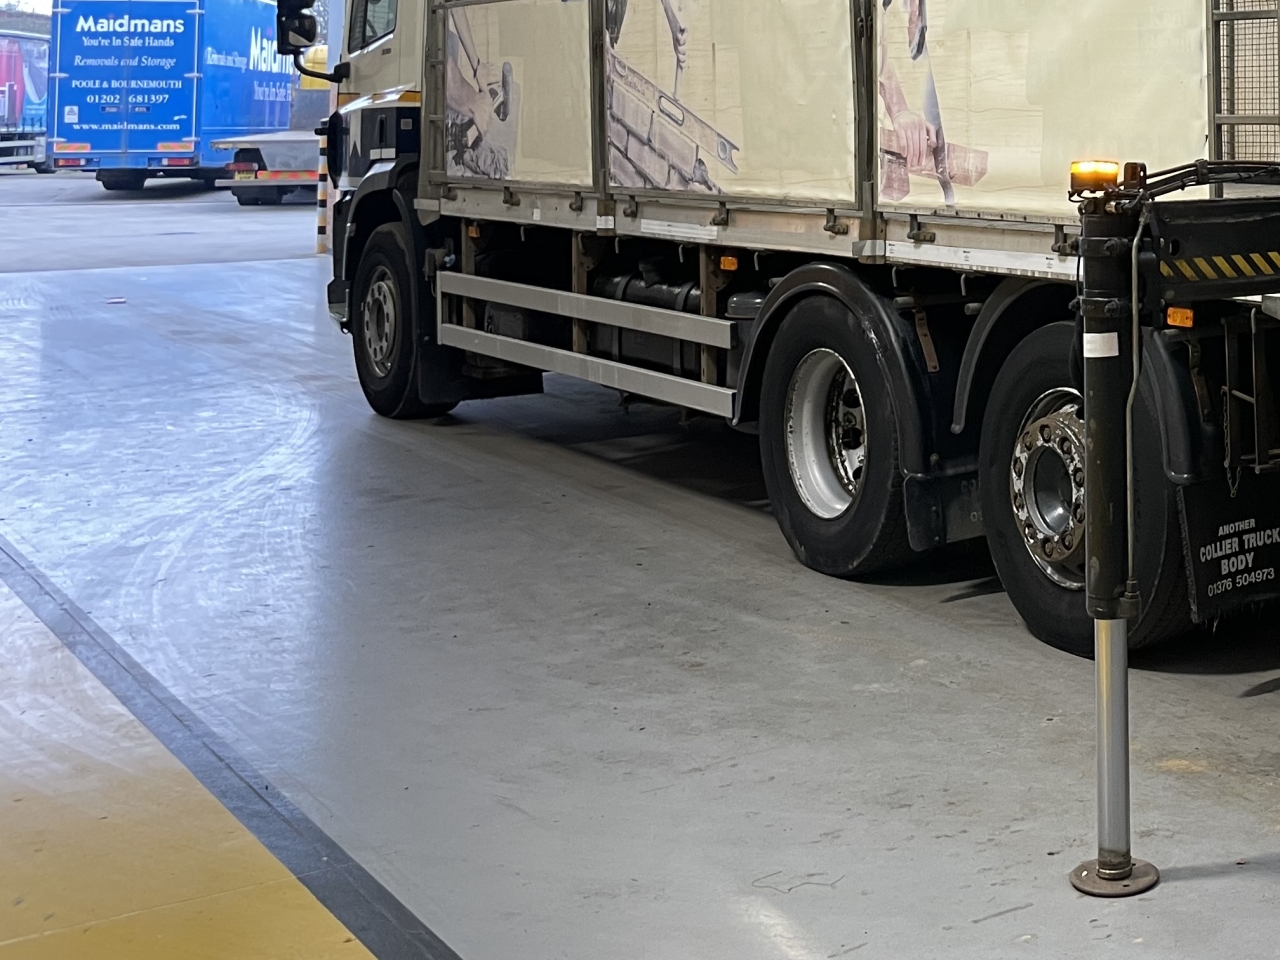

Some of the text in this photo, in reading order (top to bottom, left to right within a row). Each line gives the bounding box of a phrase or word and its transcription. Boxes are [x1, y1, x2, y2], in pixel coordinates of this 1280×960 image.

[76, 14, 184, 33] Maidmans
[82, 35, 174, 47] You're In Safe Hands
[74, 55, 118, 66] Removals
[141, 56, 176, 70] Storage
[72, 80, 100, 89] POOLE
[111, 80, 182, 89] BOURNEMOUTH
[87, 94, 169, 104] 01202 681397
[73, 121, 180, 130] www.maidmans.com
[1218, 518, 1256, 537] ANOTHER
[1200, 527, 1280, 563] COLLIER TRUCK
[1221, 551, 1255, 576] BODY
[1207, 567, 1275, 597] 01376 504973
